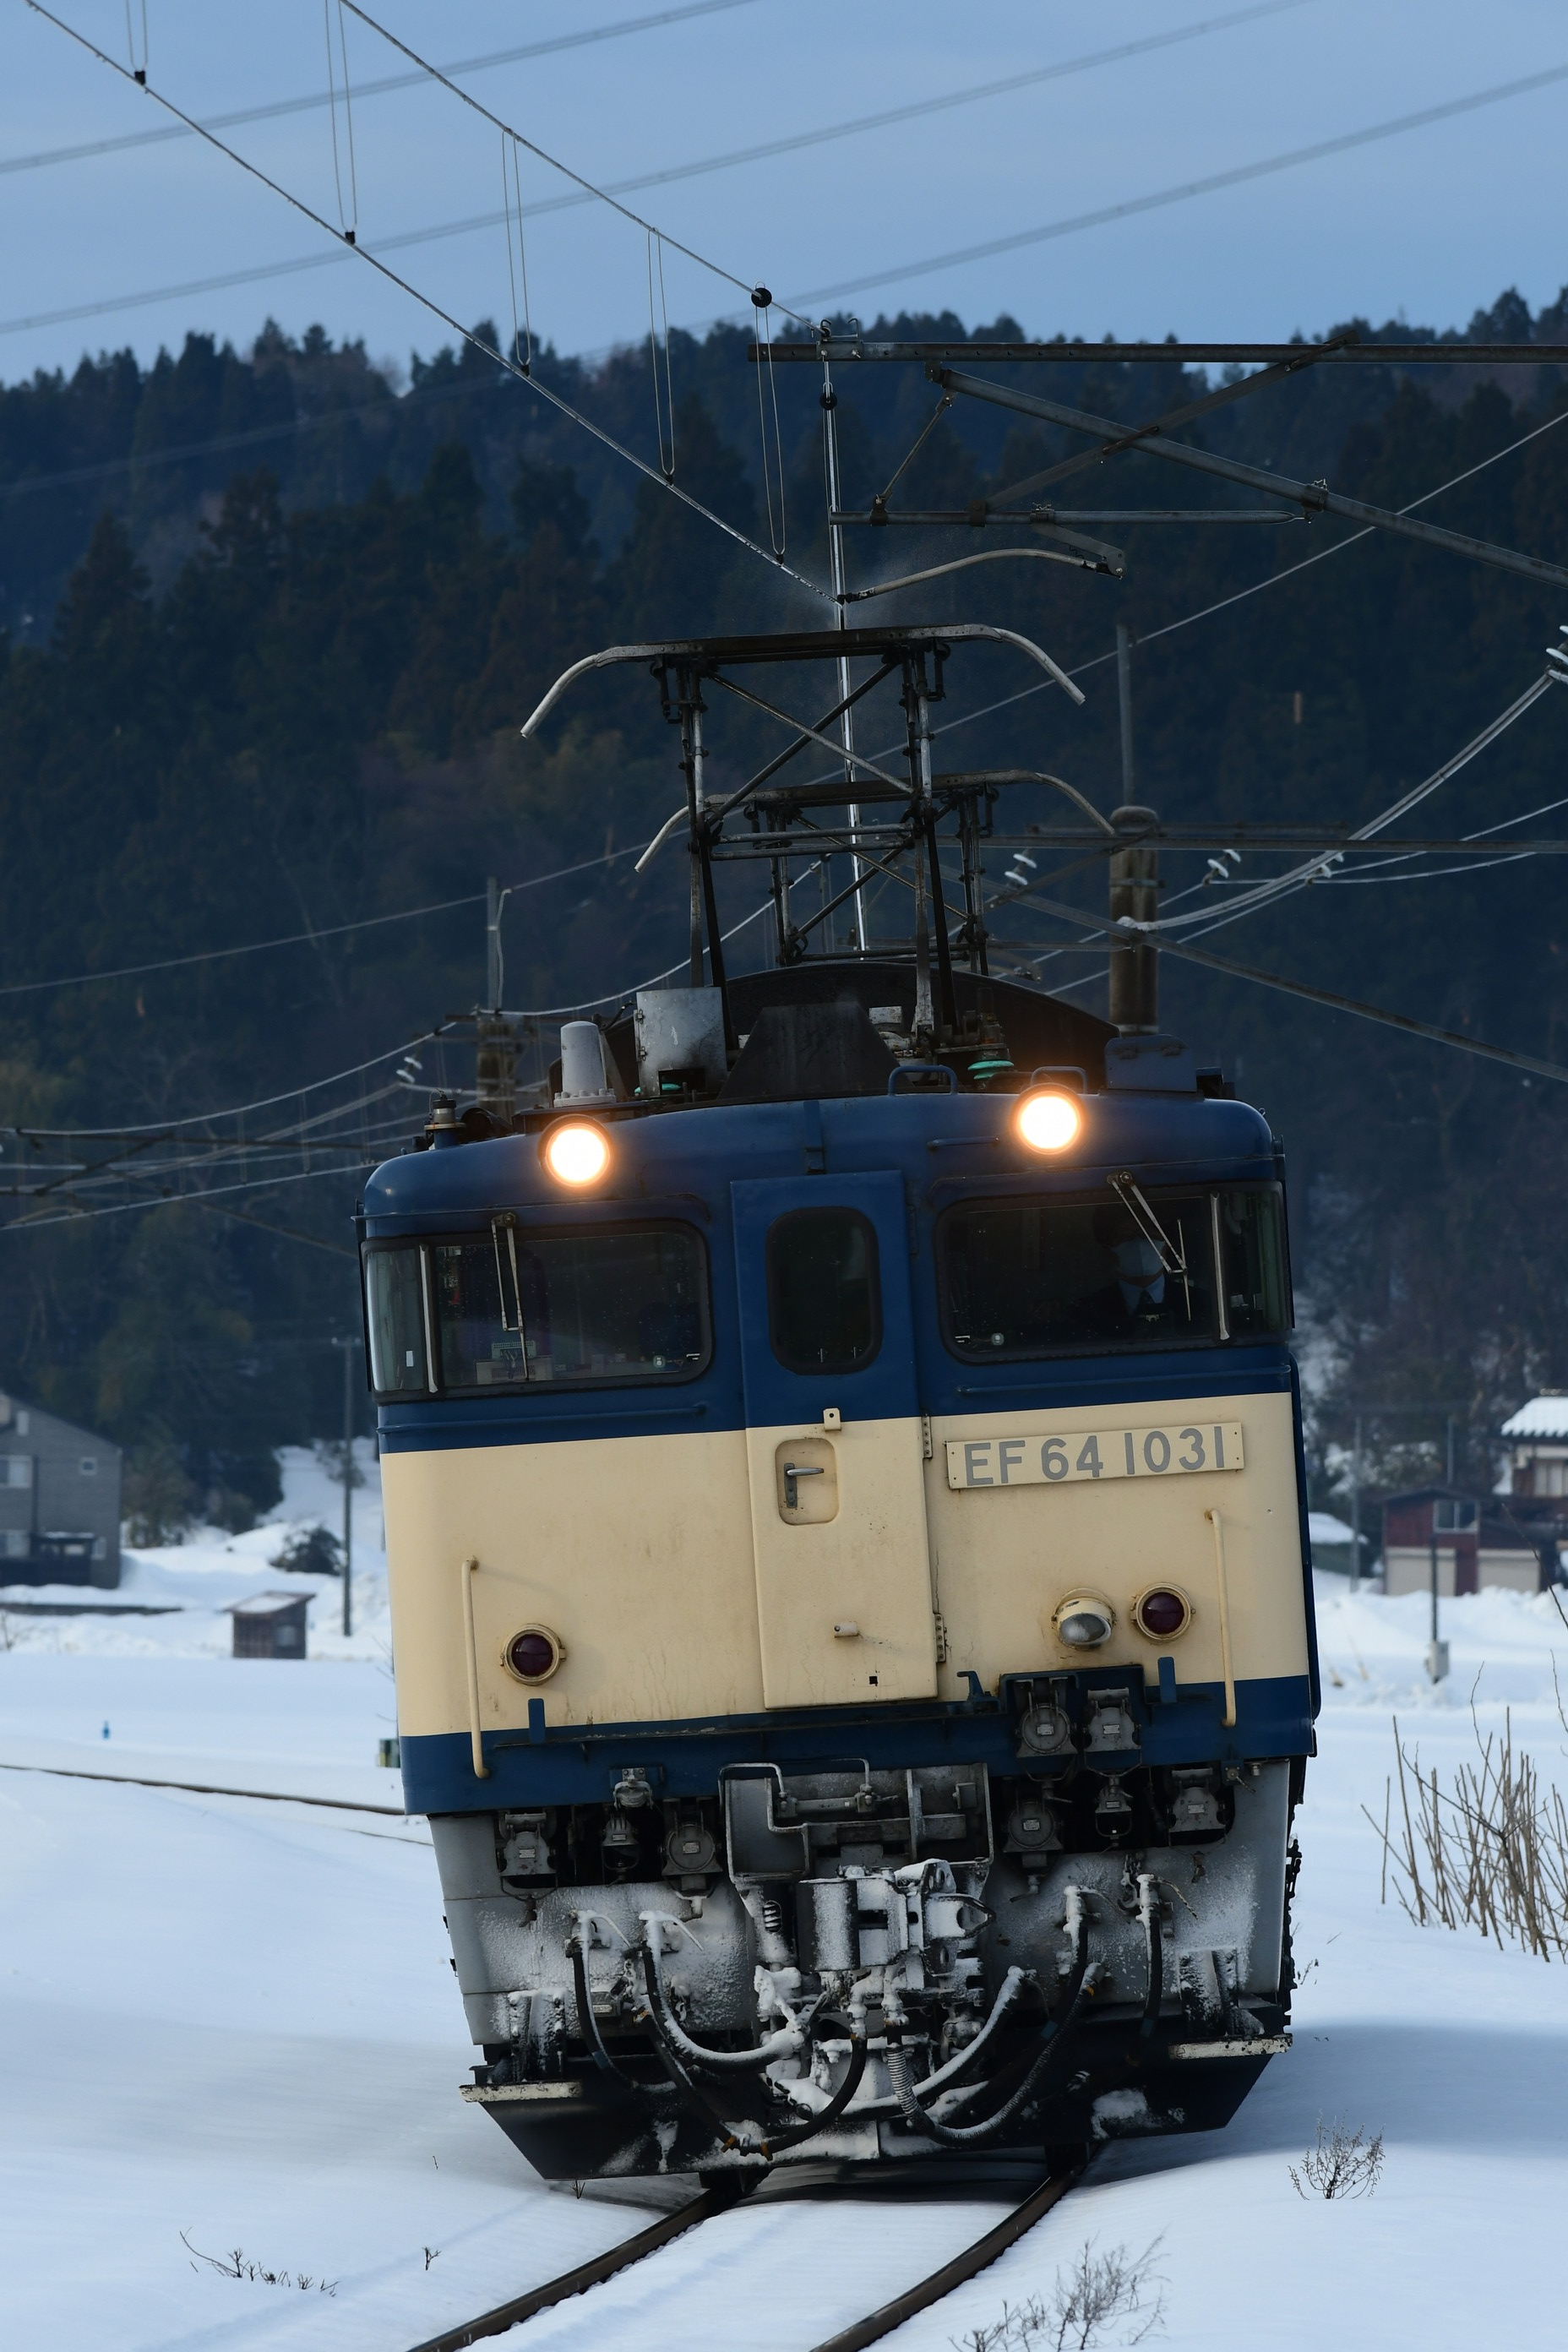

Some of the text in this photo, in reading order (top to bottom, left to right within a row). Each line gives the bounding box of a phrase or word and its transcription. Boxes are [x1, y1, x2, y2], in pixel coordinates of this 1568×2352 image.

[964, 1426, 1224, 1486] EF 64 1031
